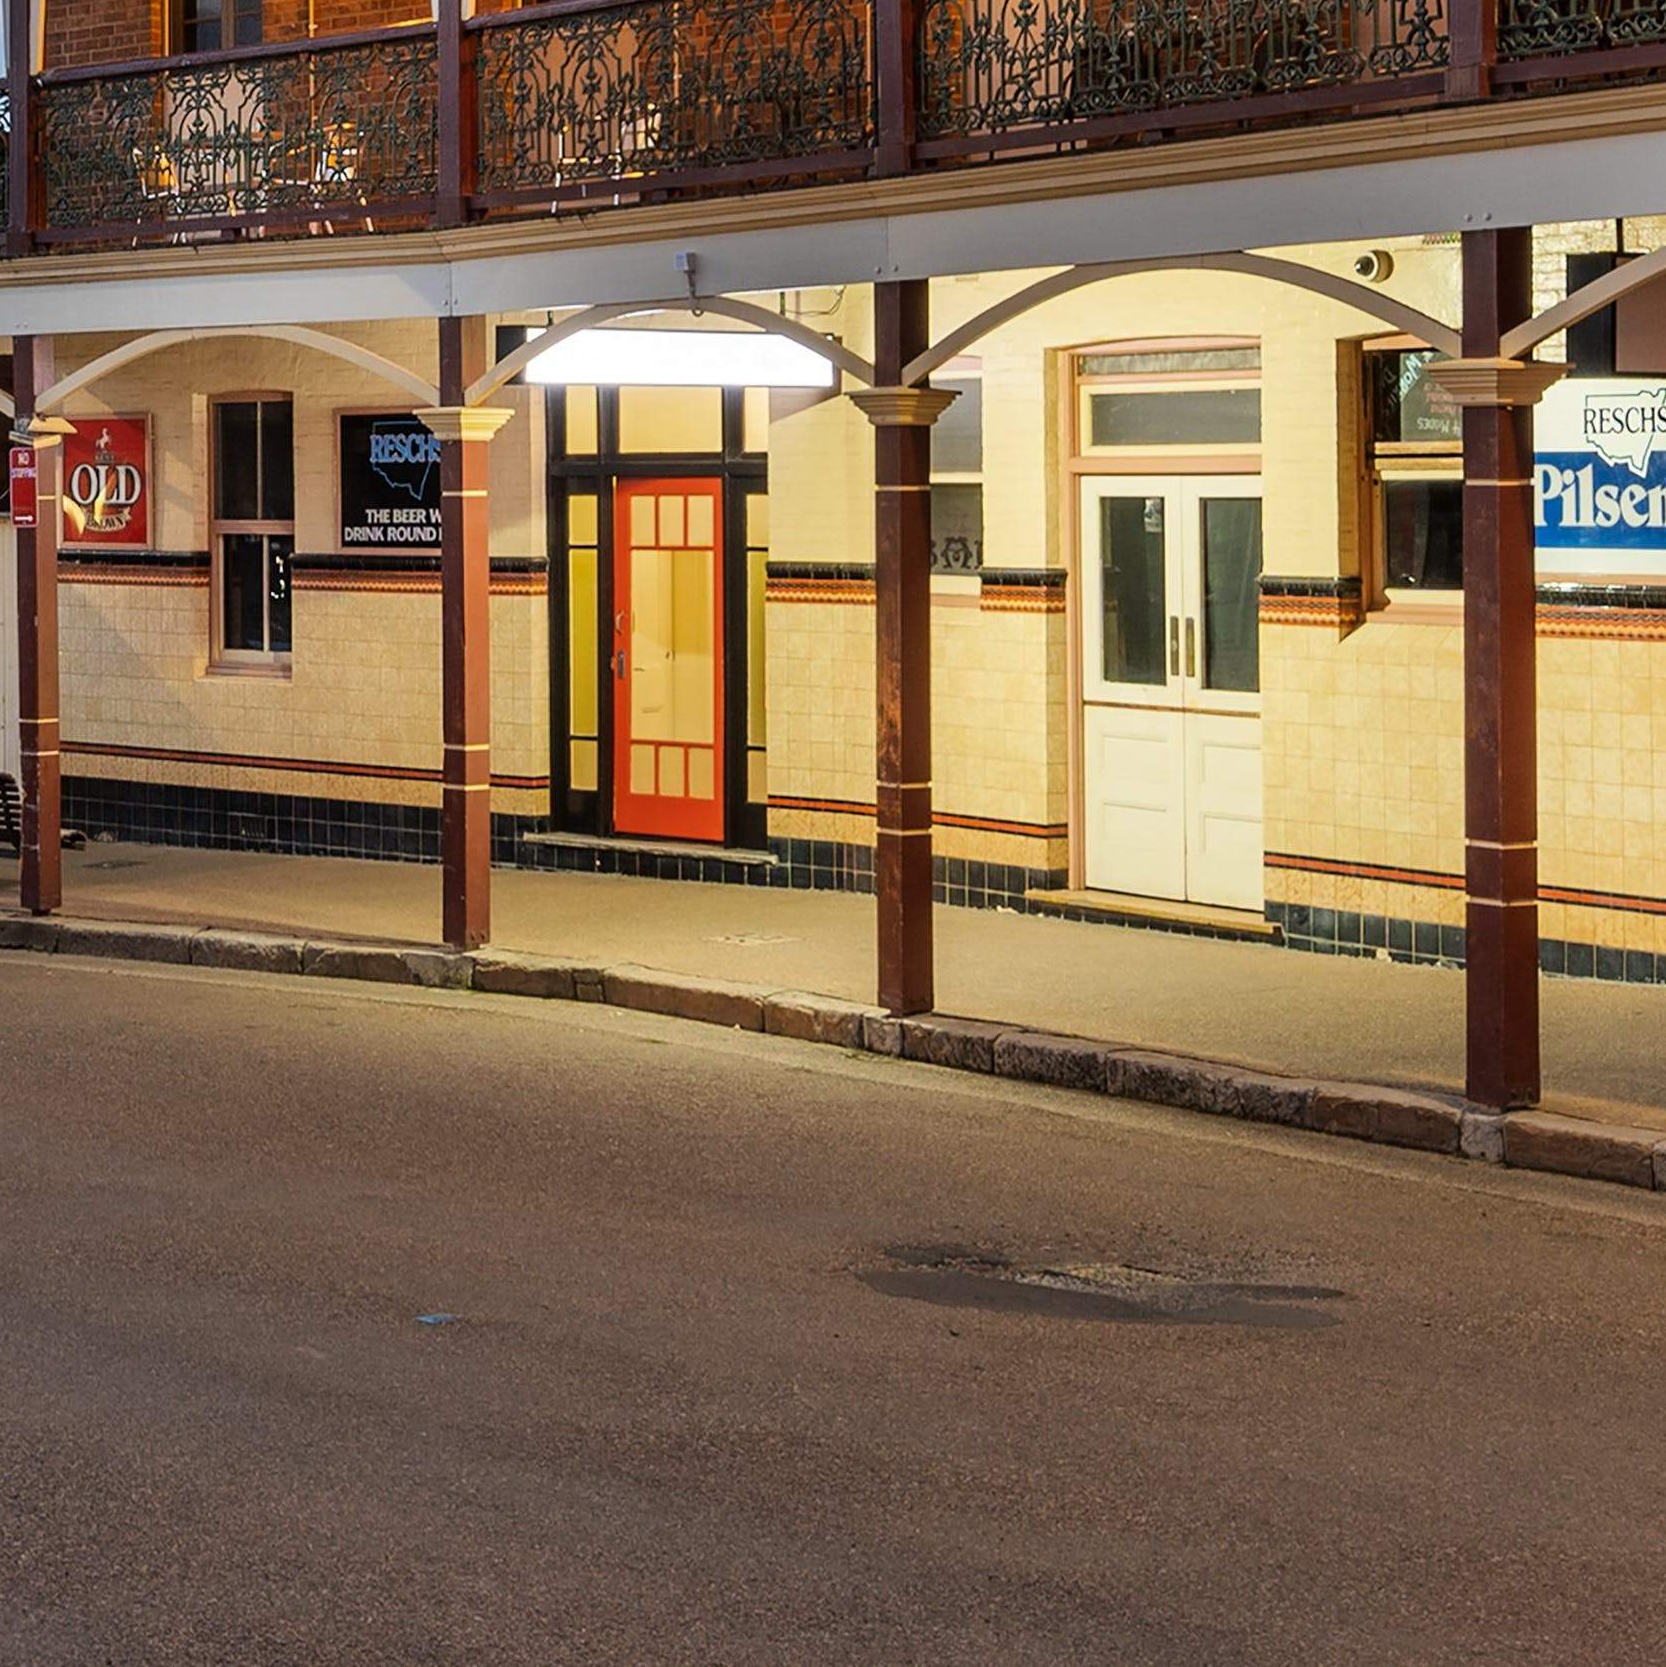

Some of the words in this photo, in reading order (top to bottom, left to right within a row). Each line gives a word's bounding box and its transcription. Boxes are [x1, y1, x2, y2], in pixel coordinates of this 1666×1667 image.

[71, 464, 142, 505] OLD
[365, 508, 390, 524] THE
[393, 508, 427, 524] BEER
[344, 526, 384, 542] DRINK
[387, 526, 437, 542] ROUND
